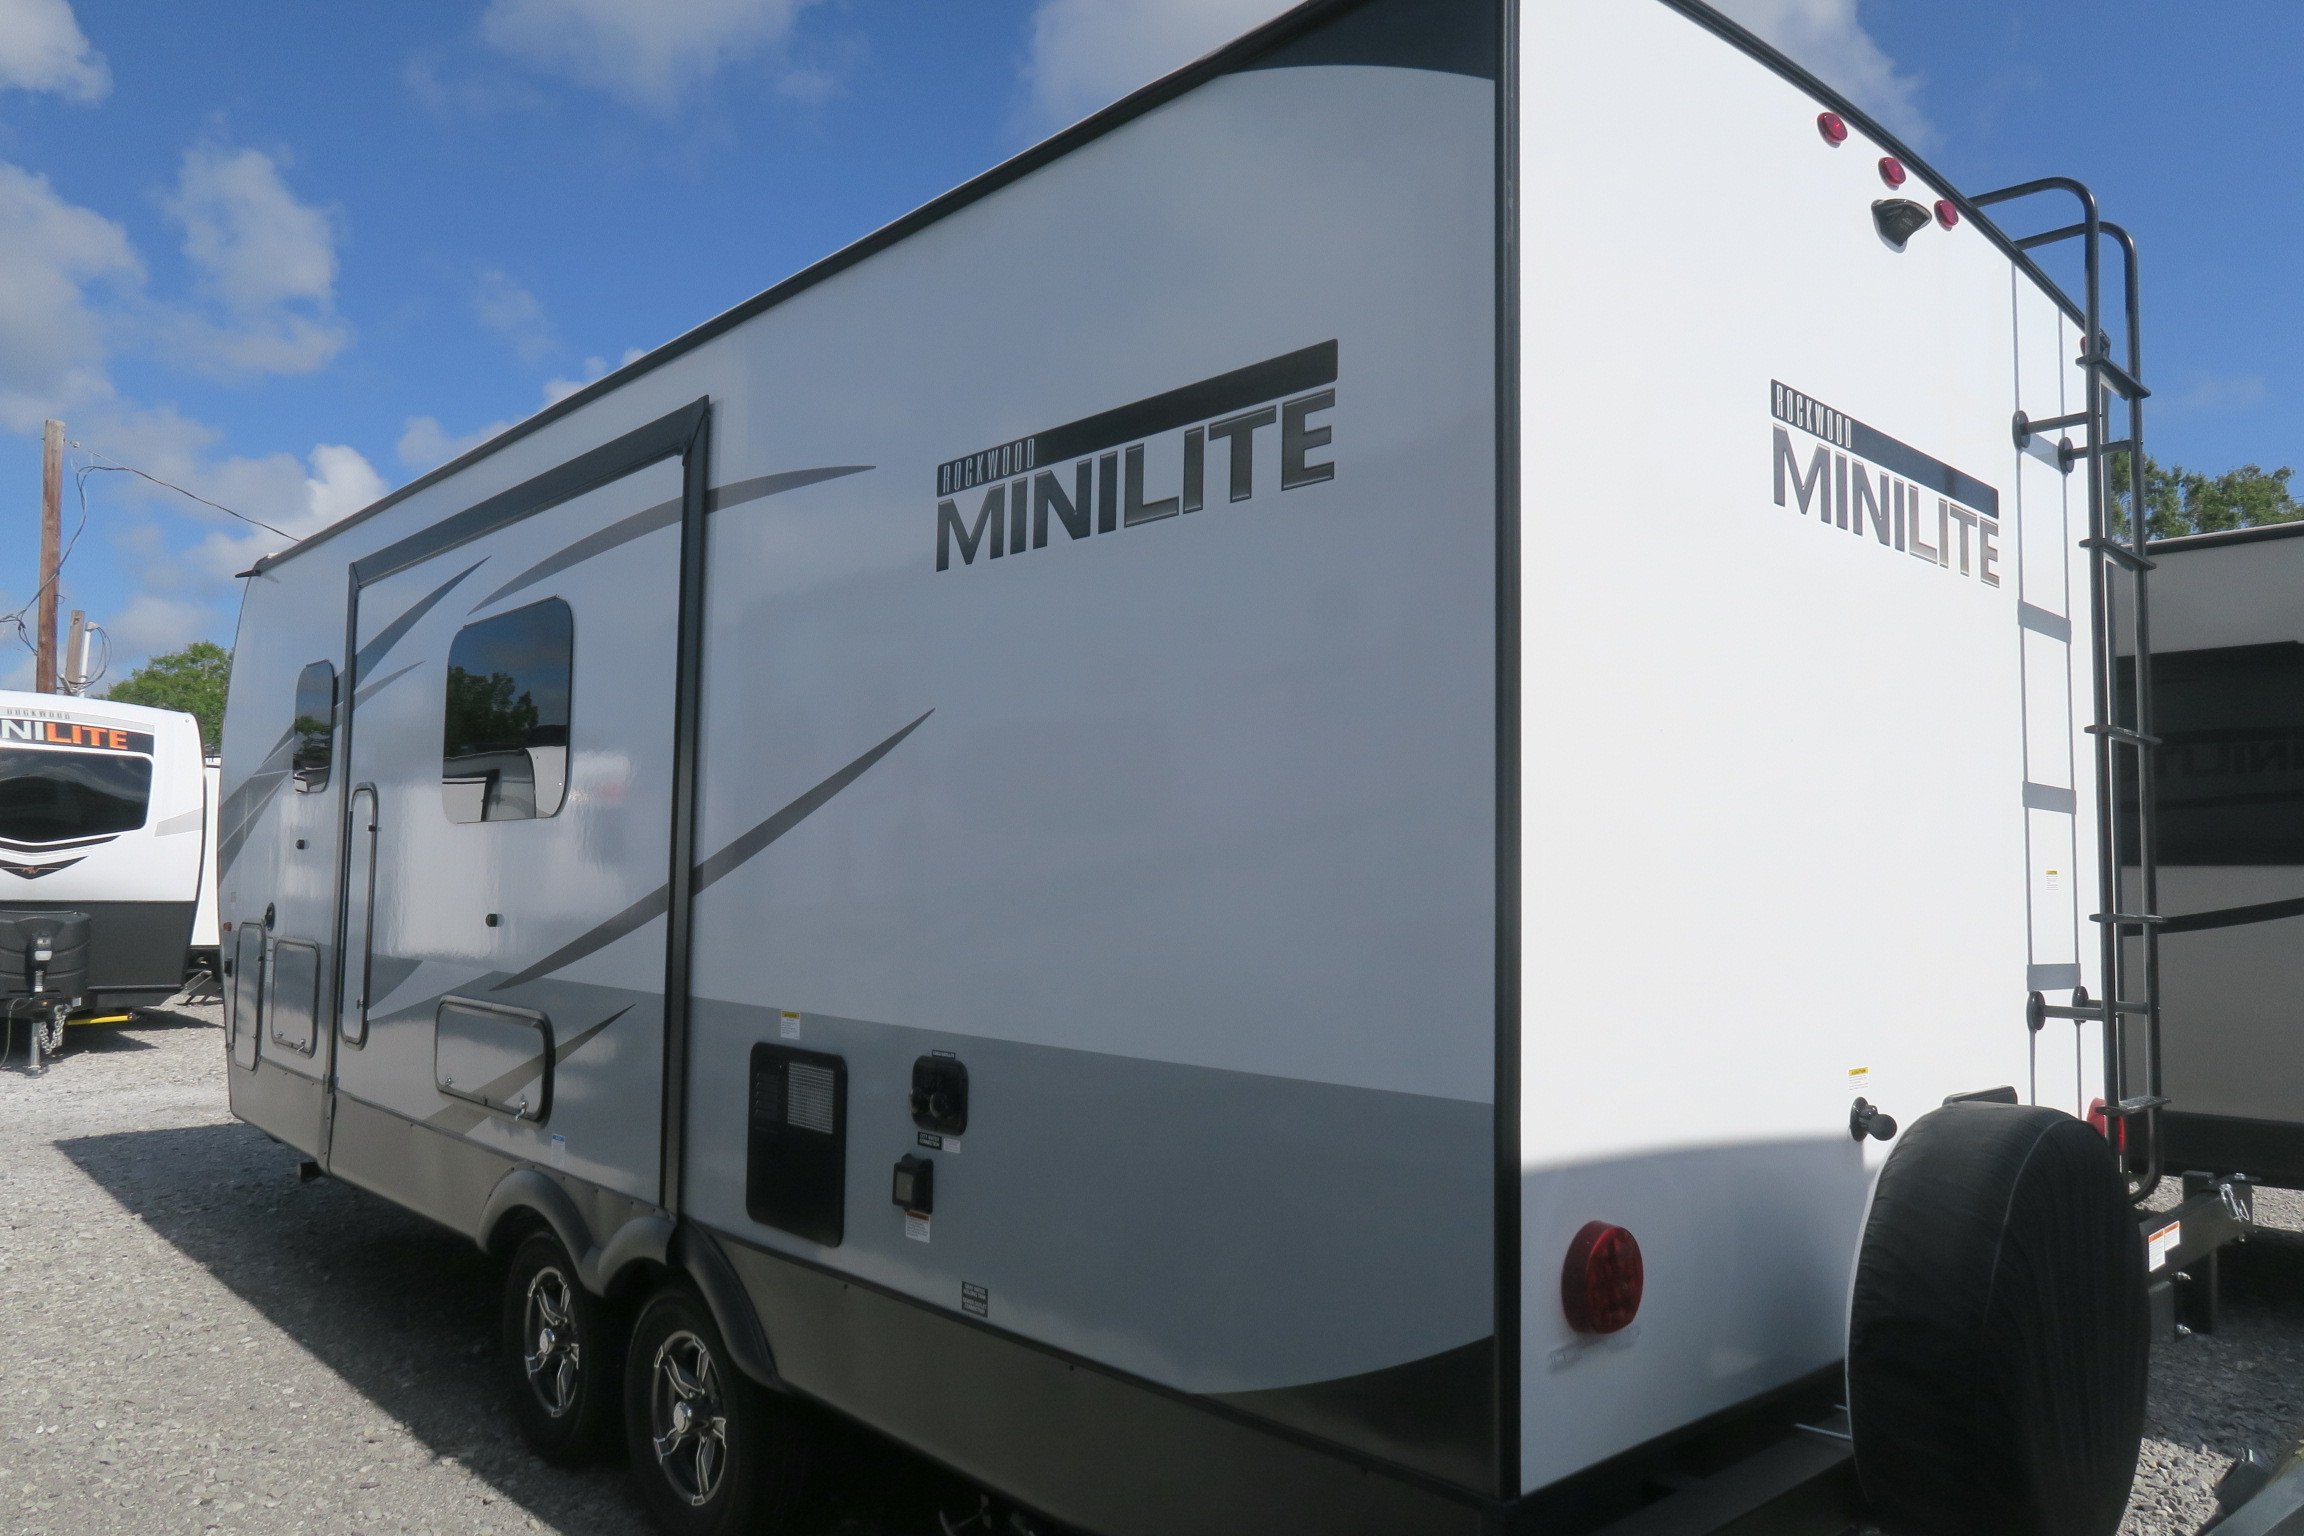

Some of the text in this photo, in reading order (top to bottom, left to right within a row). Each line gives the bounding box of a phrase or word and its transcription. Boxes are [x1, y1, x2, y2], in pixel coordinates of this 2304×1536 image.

[942, 437, 1035, 494] ROCKWOOD
[1776, 383, 1852, 449] ROCKWOOD
[936, 387, 1335, 572] MINILITE
[1772, 422, 2000, 588] MINILITE
